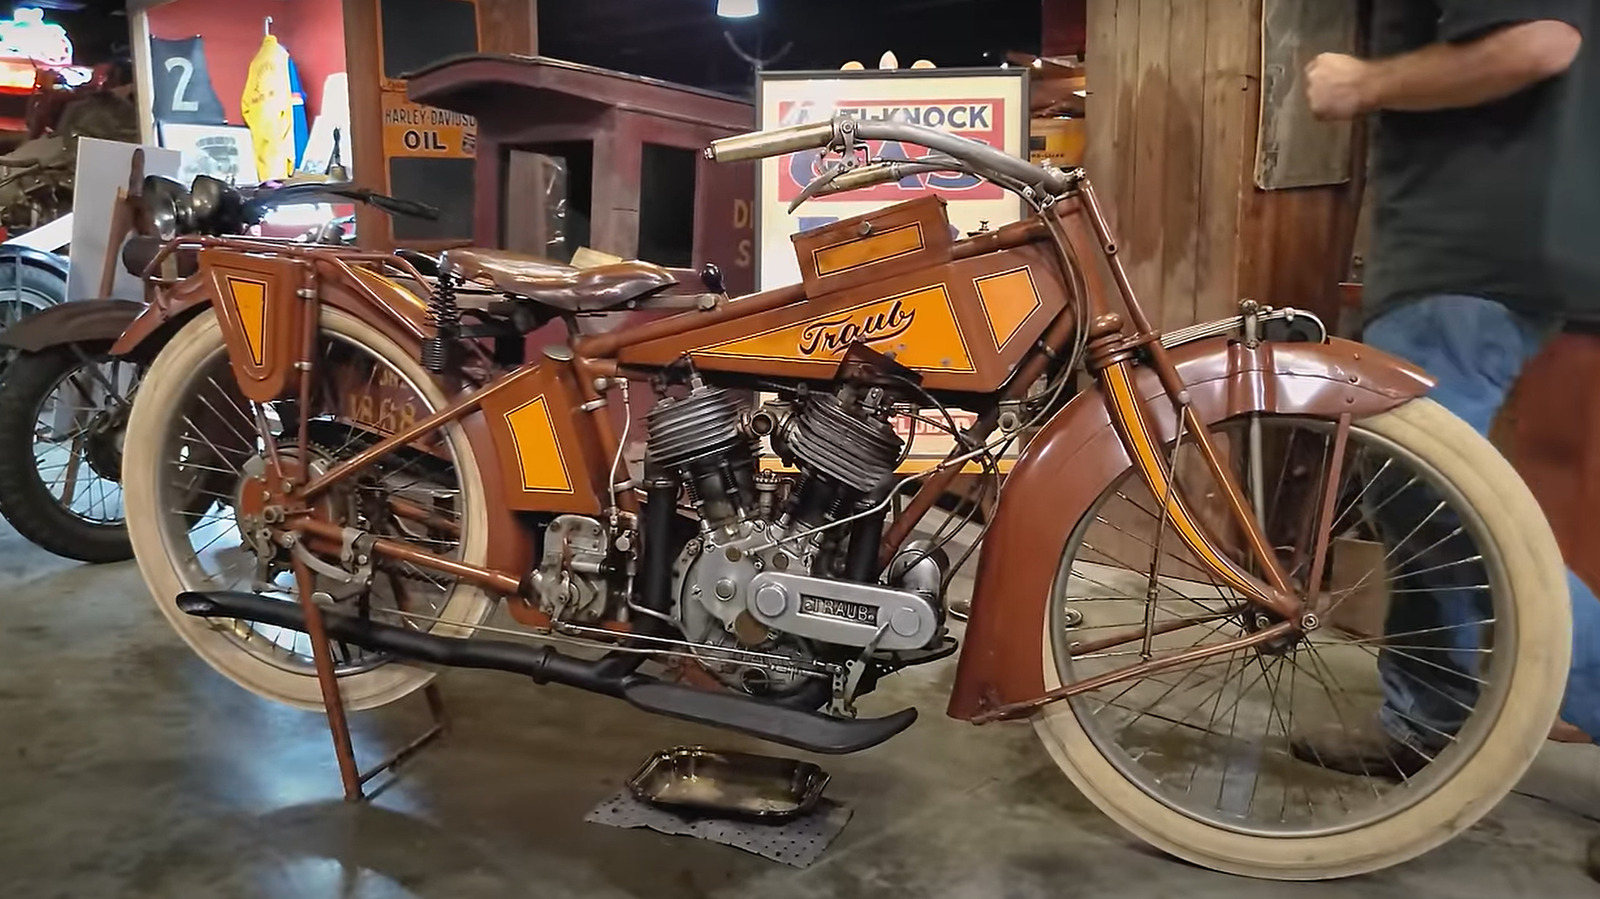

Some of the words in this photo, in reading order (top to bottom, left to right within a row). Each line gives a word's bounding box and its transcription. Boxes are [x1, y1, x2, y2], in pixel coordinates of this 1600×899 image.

[164, 56, 199, 112] 2
[796, 104, 989, 131] TI-KNOCK
[403, 129, 447, 150] OIL
[799, 299, 916, 356] Traub
